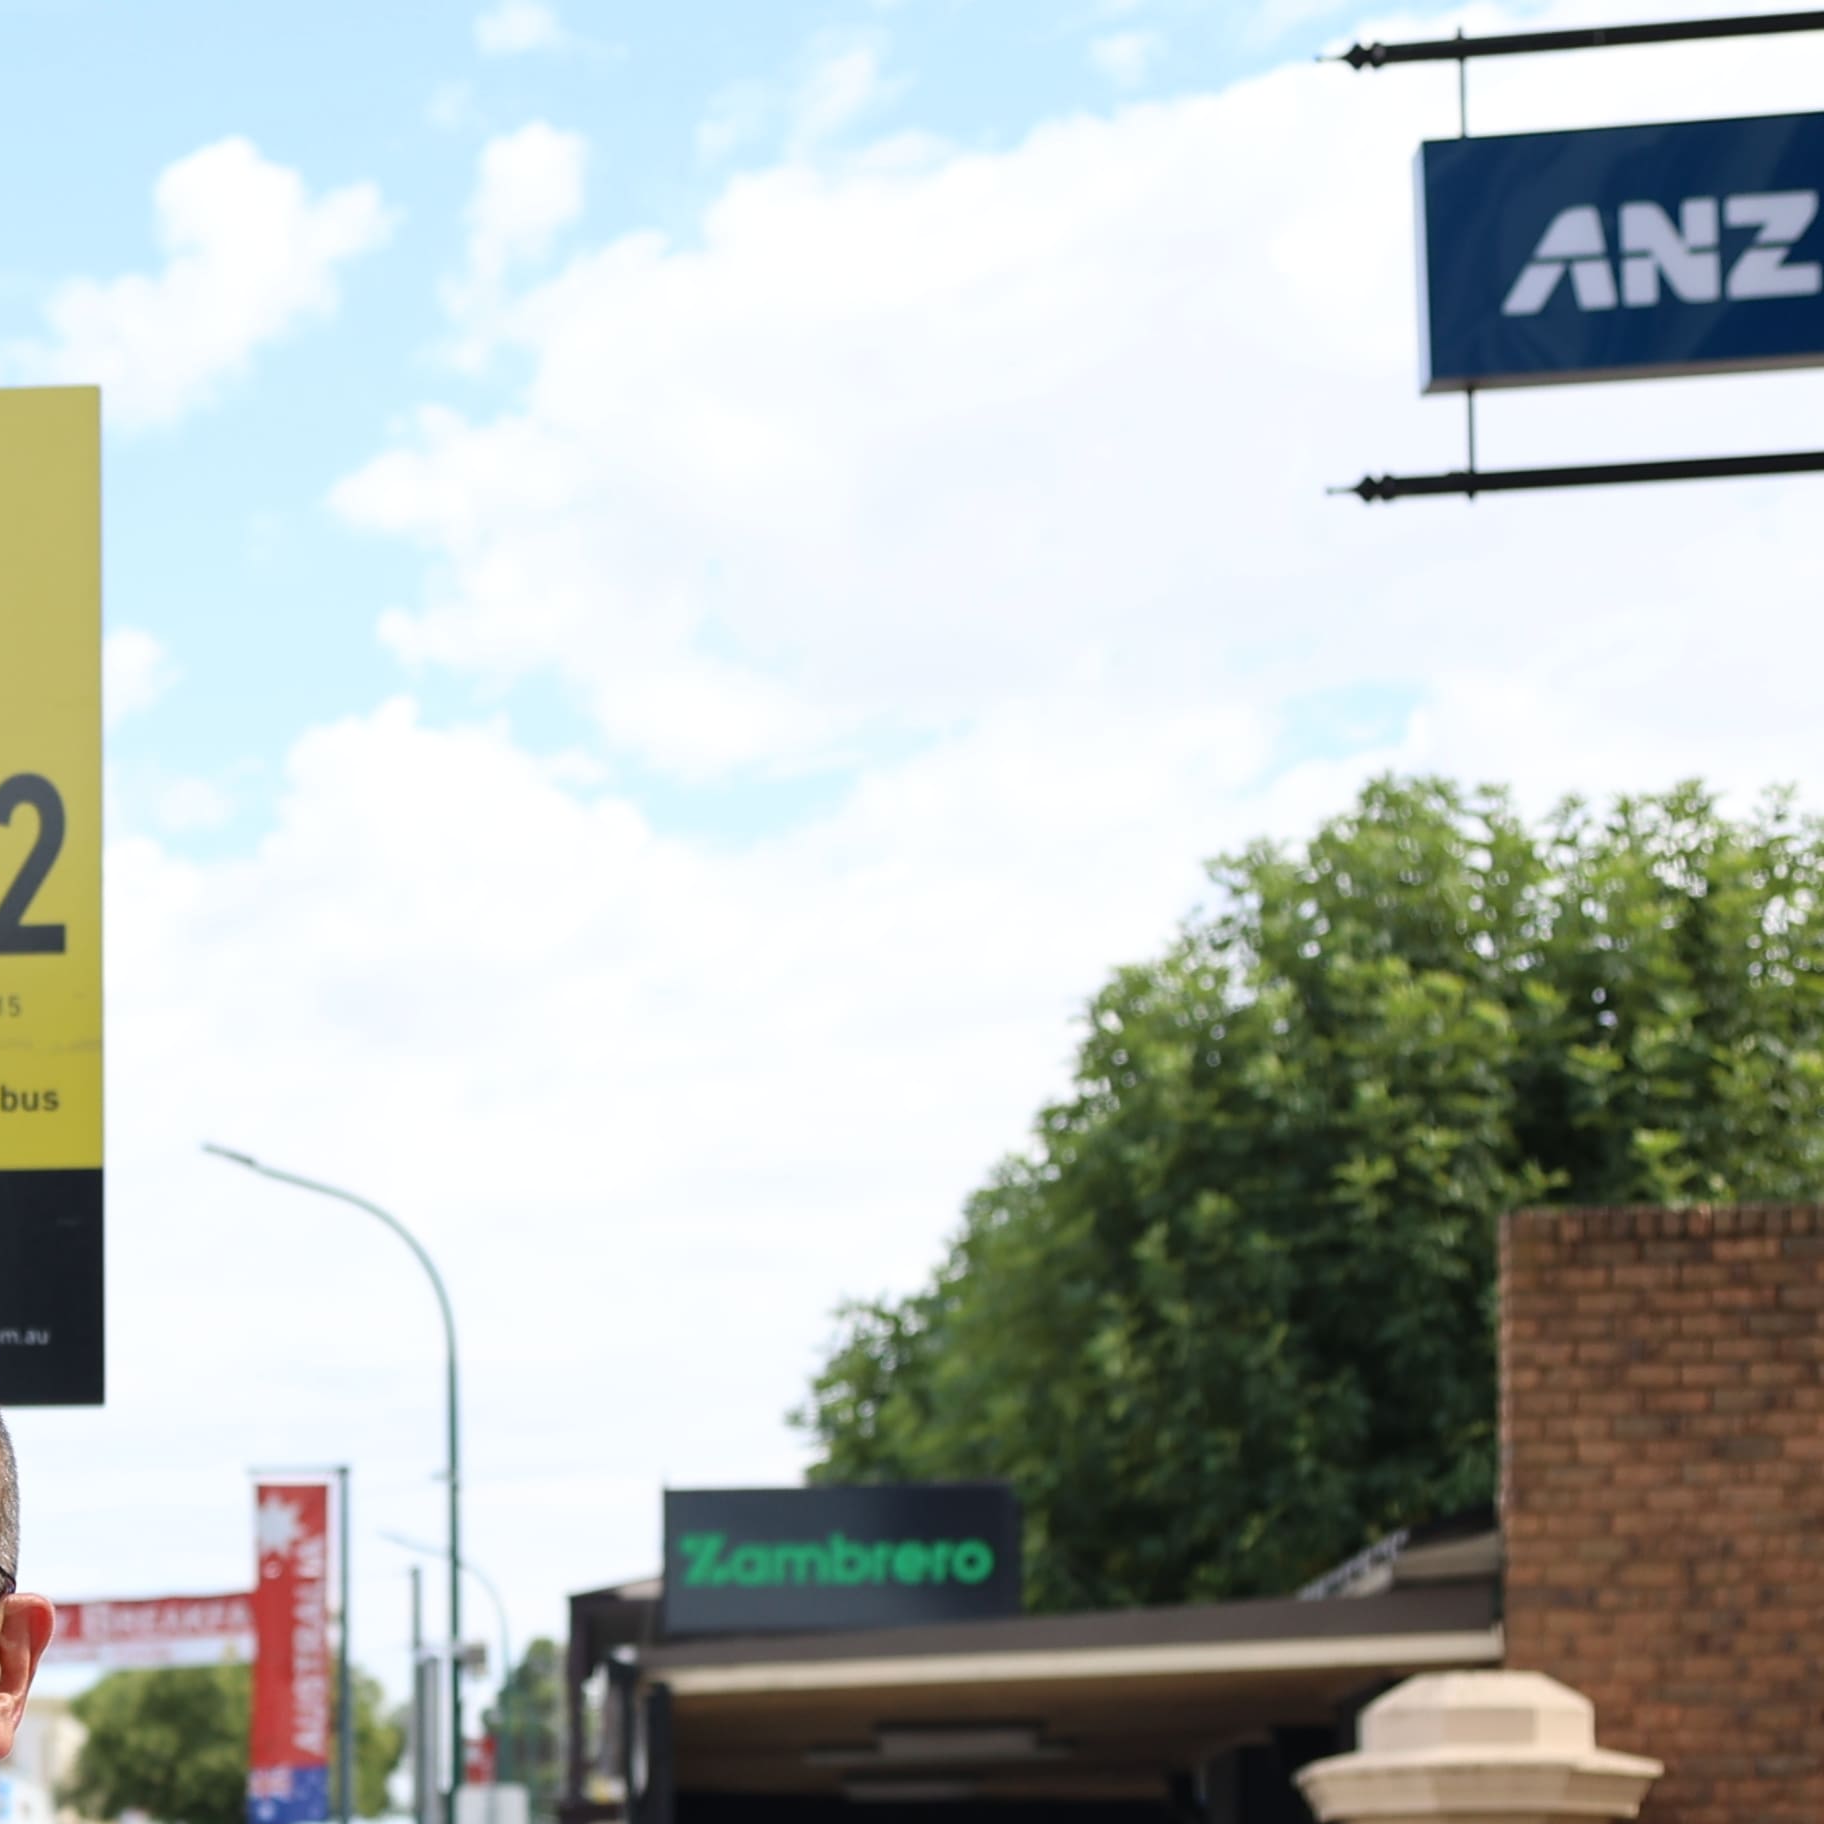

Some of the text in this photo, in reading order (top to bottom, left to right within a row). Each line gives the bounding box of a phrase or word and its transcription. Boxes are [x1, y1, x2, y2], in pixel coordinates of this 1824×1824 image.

[1501, 190, 1823, 316] ANZ
[0, 1084, 60, 1112] bus
[680, 1530, 995, 1588] Zambrero
